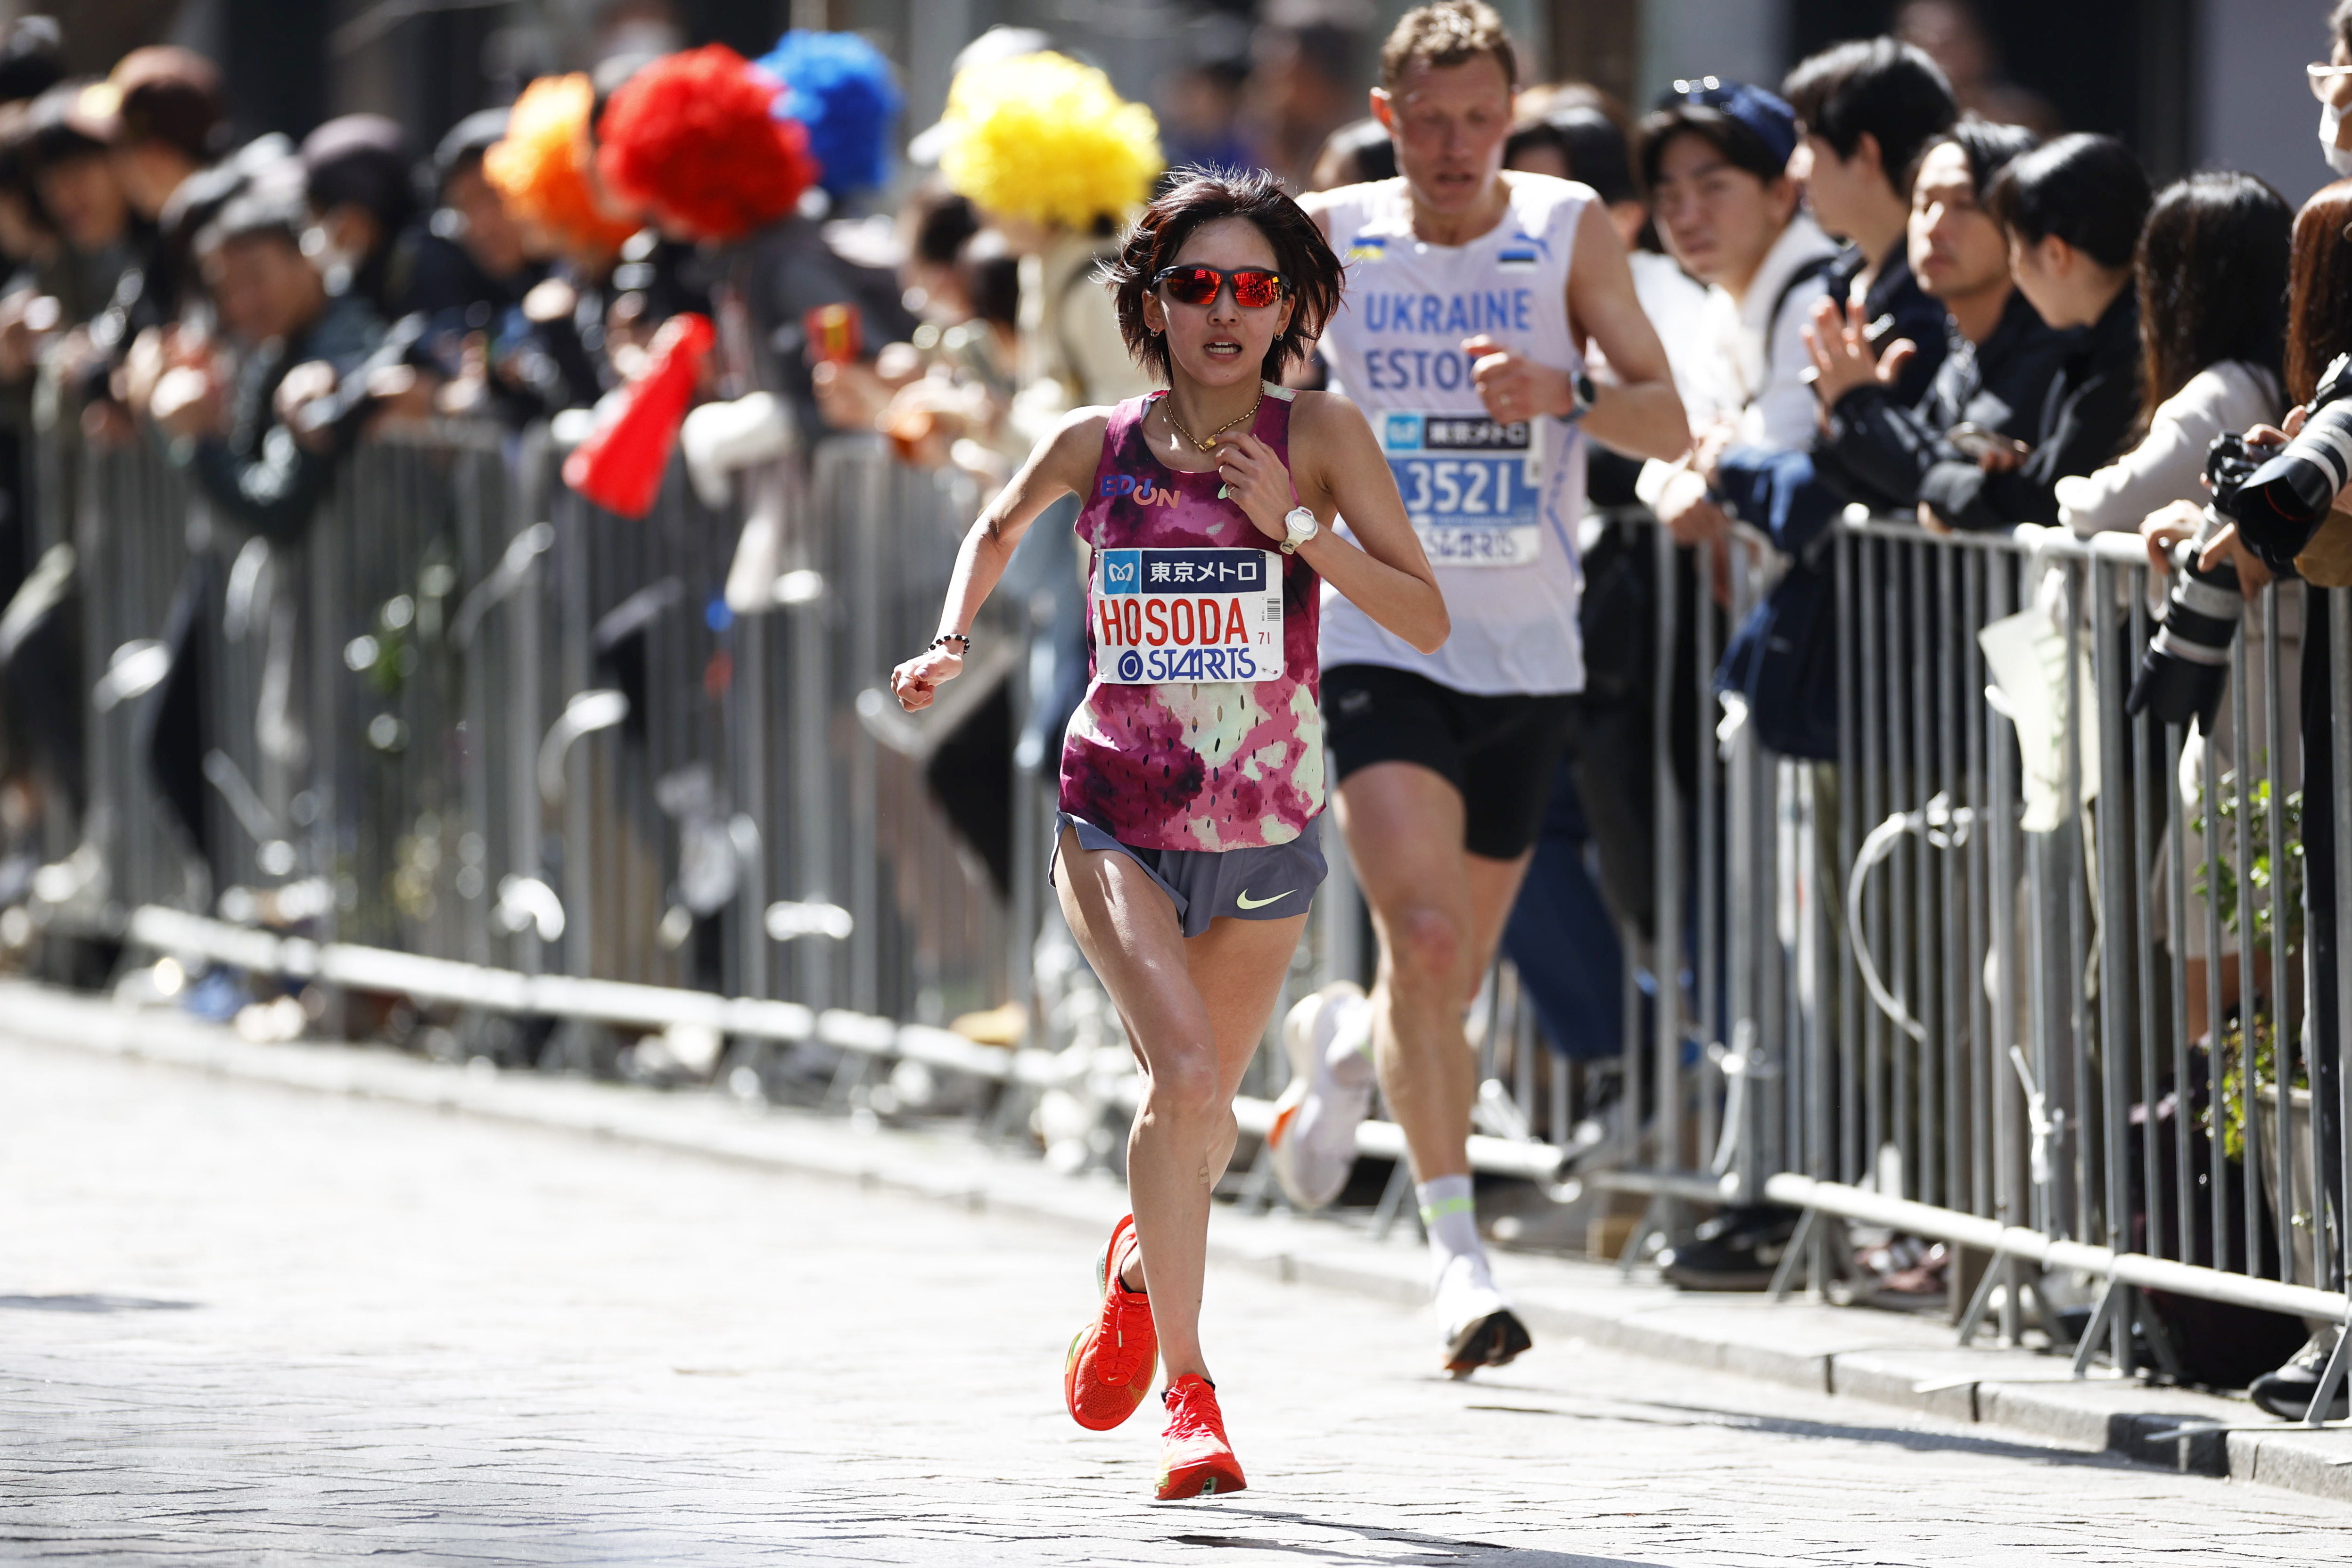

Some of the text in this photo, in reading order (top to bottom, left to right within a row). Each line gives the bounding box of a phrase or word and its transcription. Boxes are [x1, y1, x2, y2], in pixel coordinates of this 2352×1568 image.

[1365, 289, 1531, 332] UKRAINE
[1365, 350, 1475, 391] ESTO
[1101, 475, 1181, 509] EDION
[1407, 461, 1510, 513] 3521
[1150, 562, 1257, 583] 東京メトロ
[1099, 598, 1249, 646] HOSODA
[1258, 632, 1270, 644] 71
